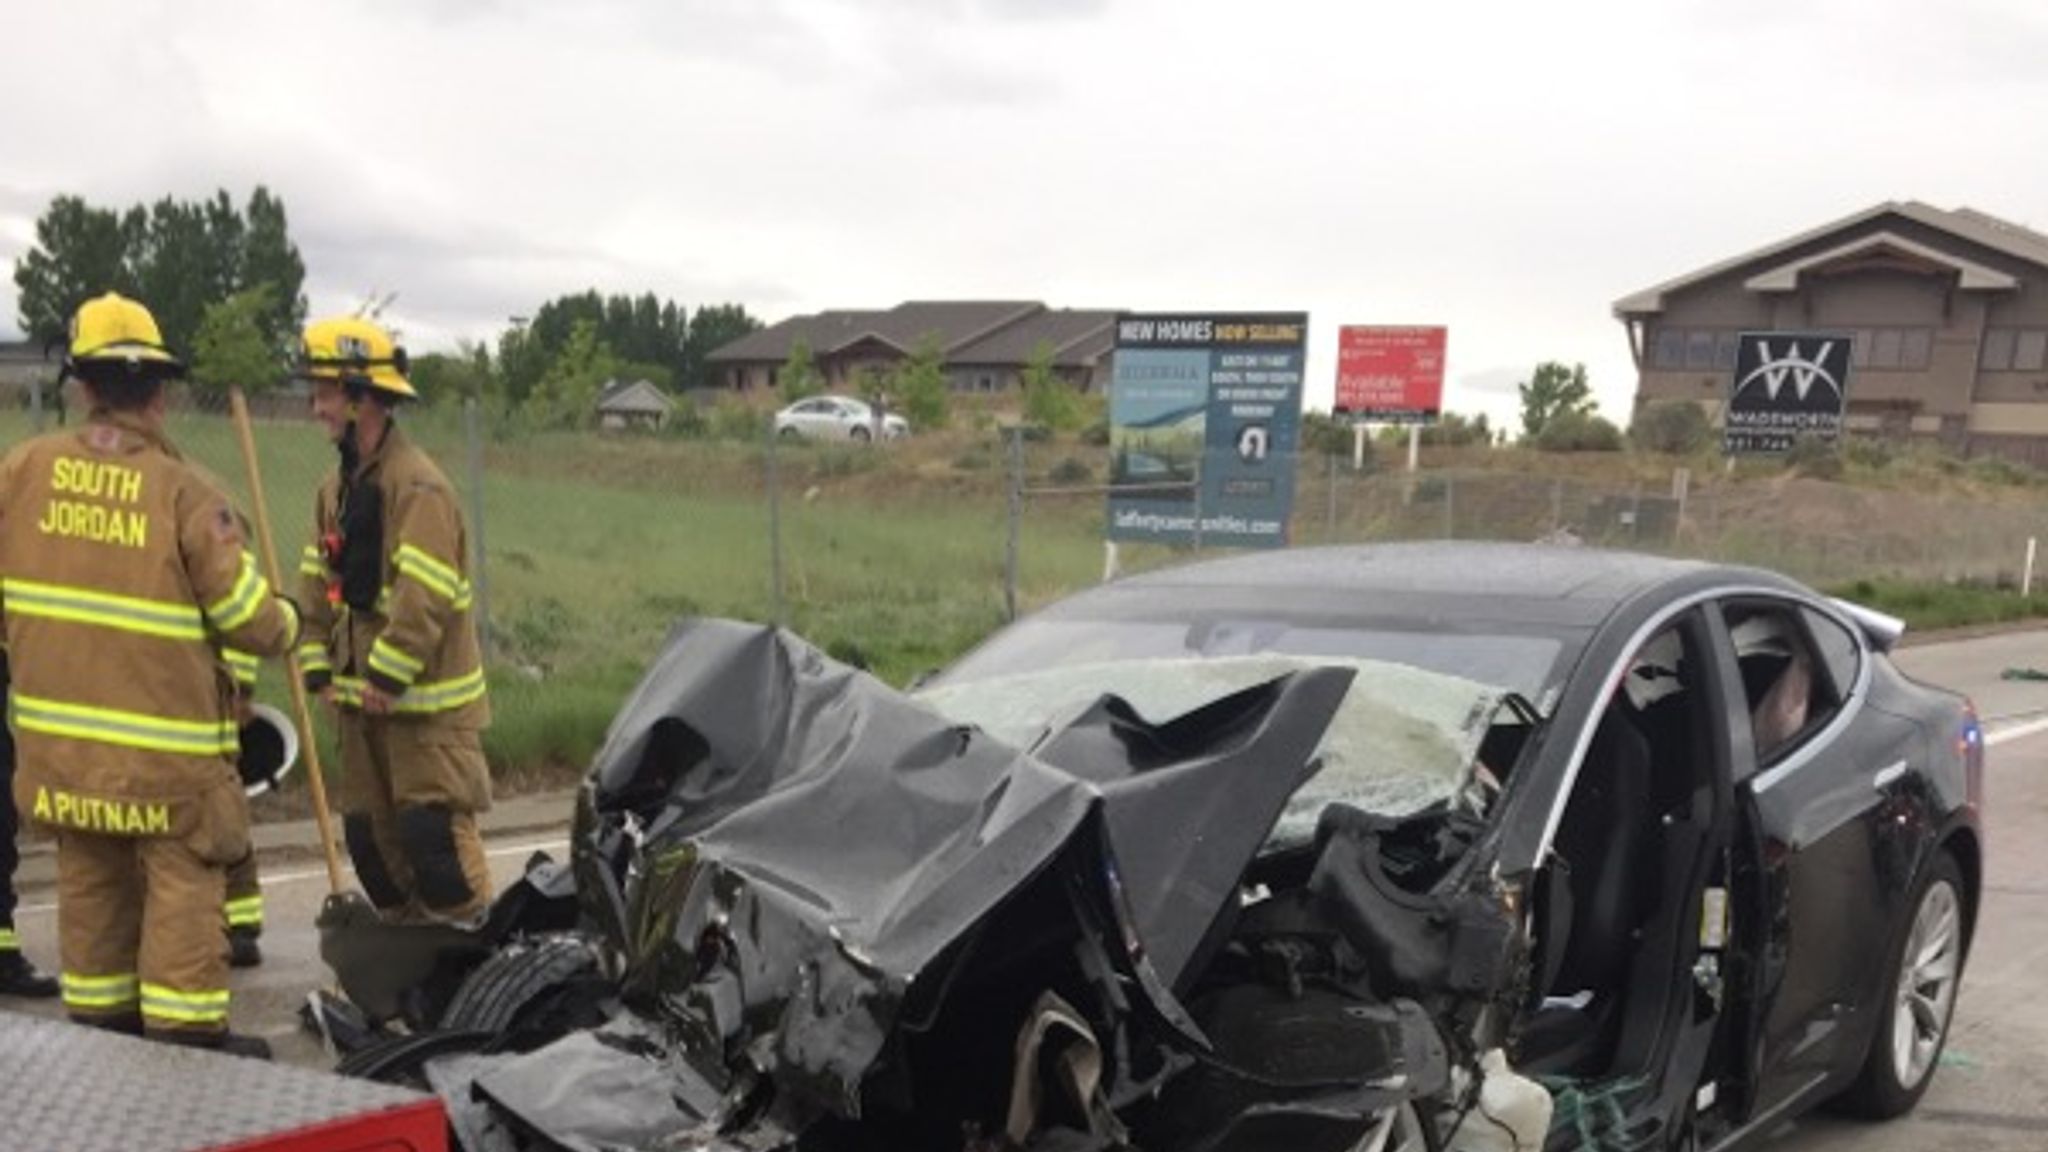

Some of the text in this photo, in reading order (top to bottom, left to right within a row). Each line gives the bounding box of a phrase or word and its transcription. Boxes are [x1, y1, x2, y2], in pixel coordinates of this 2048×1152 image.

[1119, 320, 1153, 340] NEW
[1157, 320, 1213, 341] HOMES
[51, 457, 142, 502] SOUTH
[38, 502, 147, 549] JORDAN
